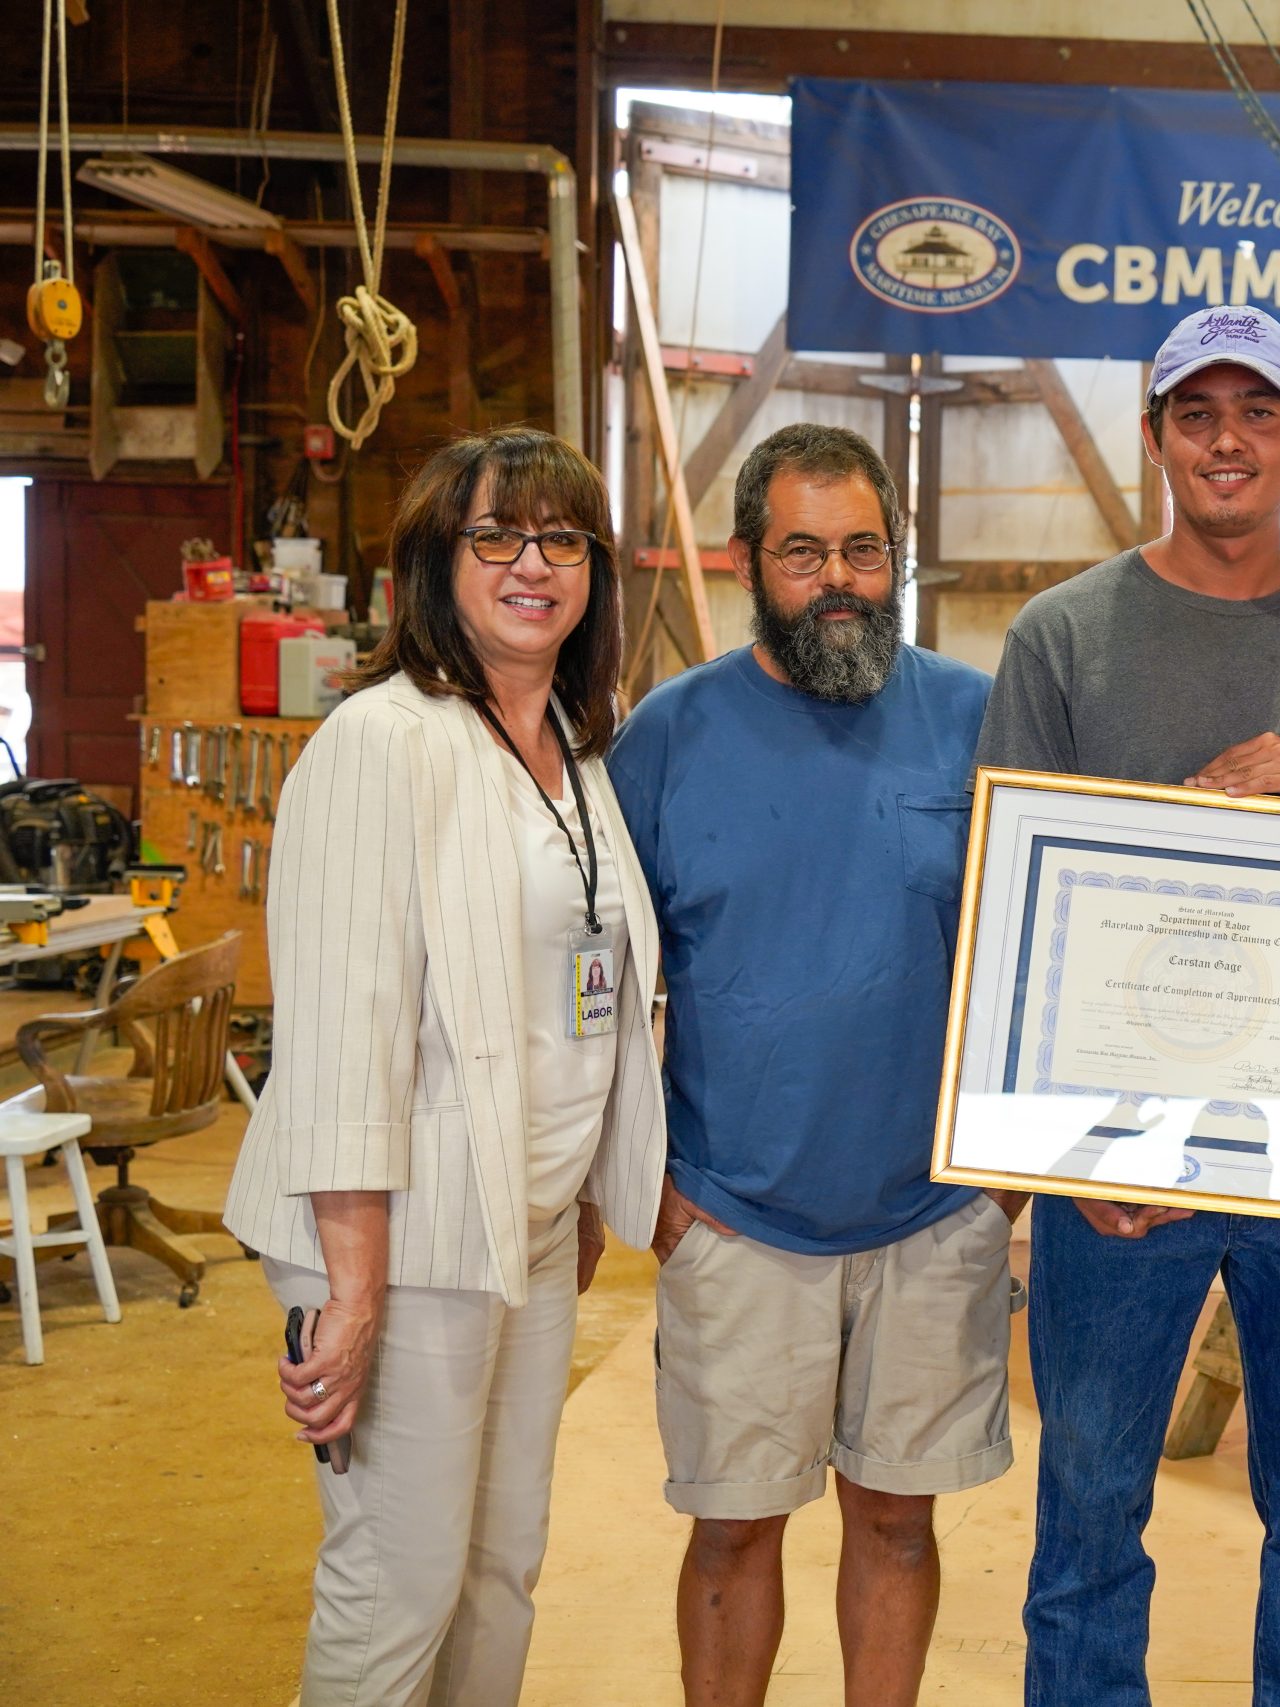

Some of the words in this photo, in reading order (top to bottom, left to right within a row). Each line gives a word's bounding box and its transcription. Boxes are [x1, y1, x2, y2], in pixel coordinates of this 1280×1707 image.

[1197, 313, 1268, 331] Atlantic
[1159, 913, 1211, 927] Department
[1213, 919, 1221, 928] of
[1225, 920, 1251, 931] Labor
[1100, 919, 1144, 932] Maryland
[1146, 923, 1210, 939] Apprenticeship
[1212, 932, 1228, 941] and
[1231, 933, 1271, 946] Training
[1168, 955, 1211, 969] Carstan
[1213, 959, 1242, 974] Gage
[1105, 979, 1150, 992] Certificate
[1152, 984, 1161, 993] of
[1163, 985, 1213, 998] Completion
[1215, 991, 1224, 999] of
[582, 1007, 612, 1020] LABOR
